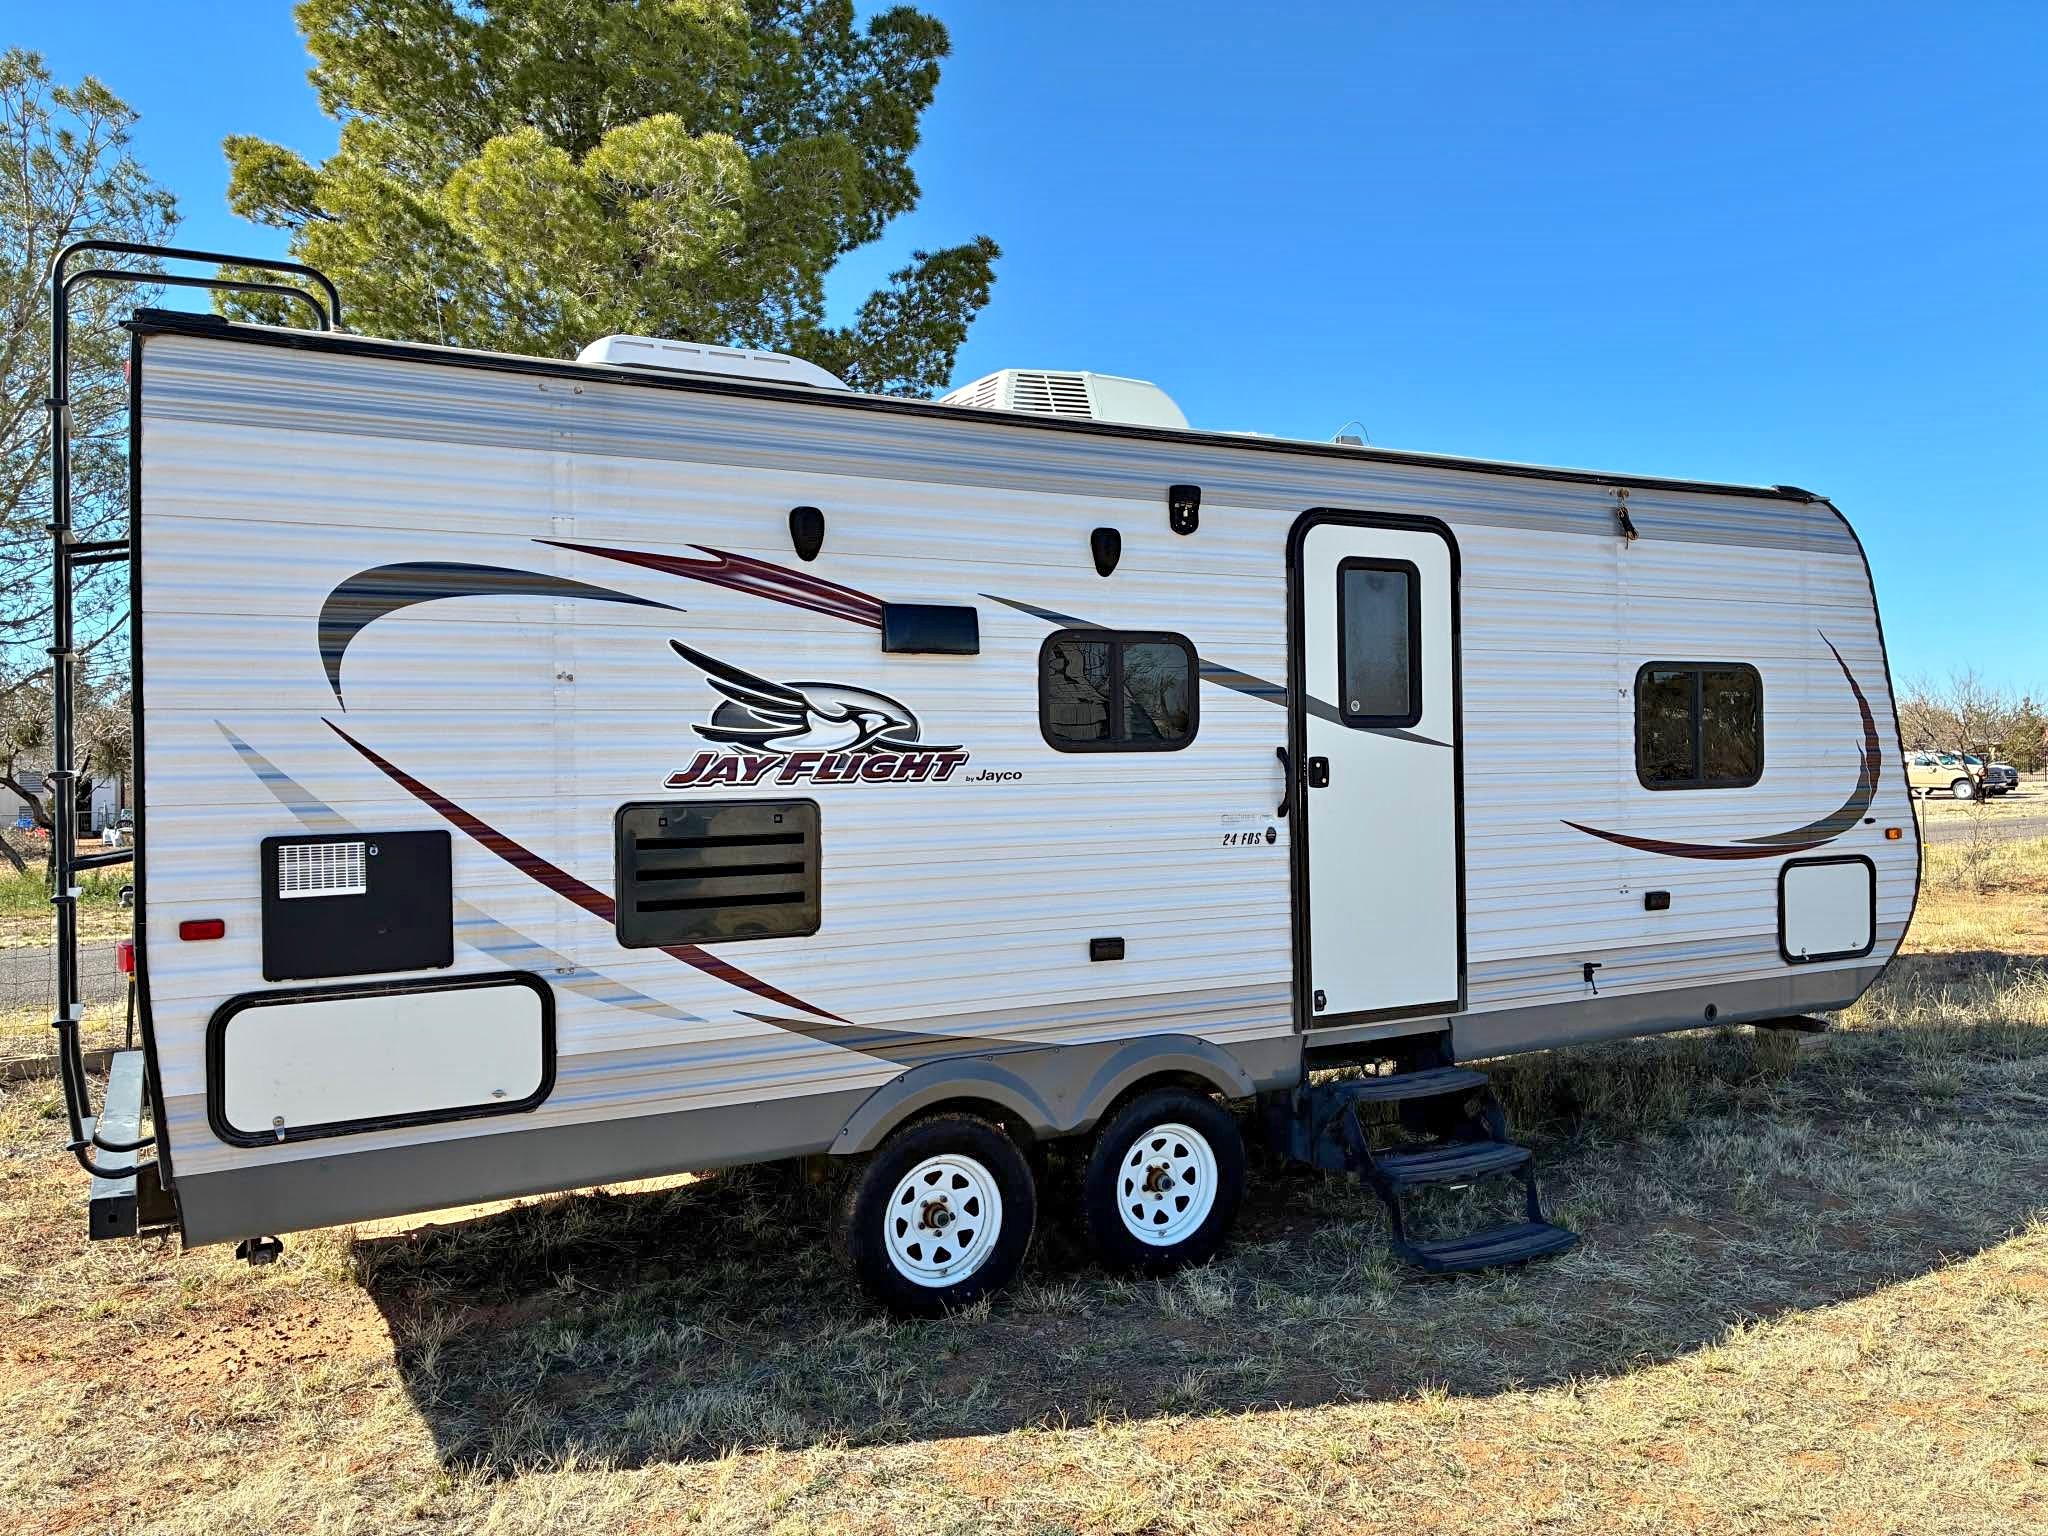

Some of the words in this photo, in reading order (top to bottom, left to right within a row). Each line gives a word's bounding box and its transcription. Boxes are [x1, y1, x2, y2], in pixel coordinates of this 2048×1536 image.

[665, 751, 783, 789] JAY
[775, 751, 969, 785] FLIGHT
[965, 775, 975, 783] by
[975, 768, 1023, 782] Jayco
[1222, 833, 1238, 846] 24
